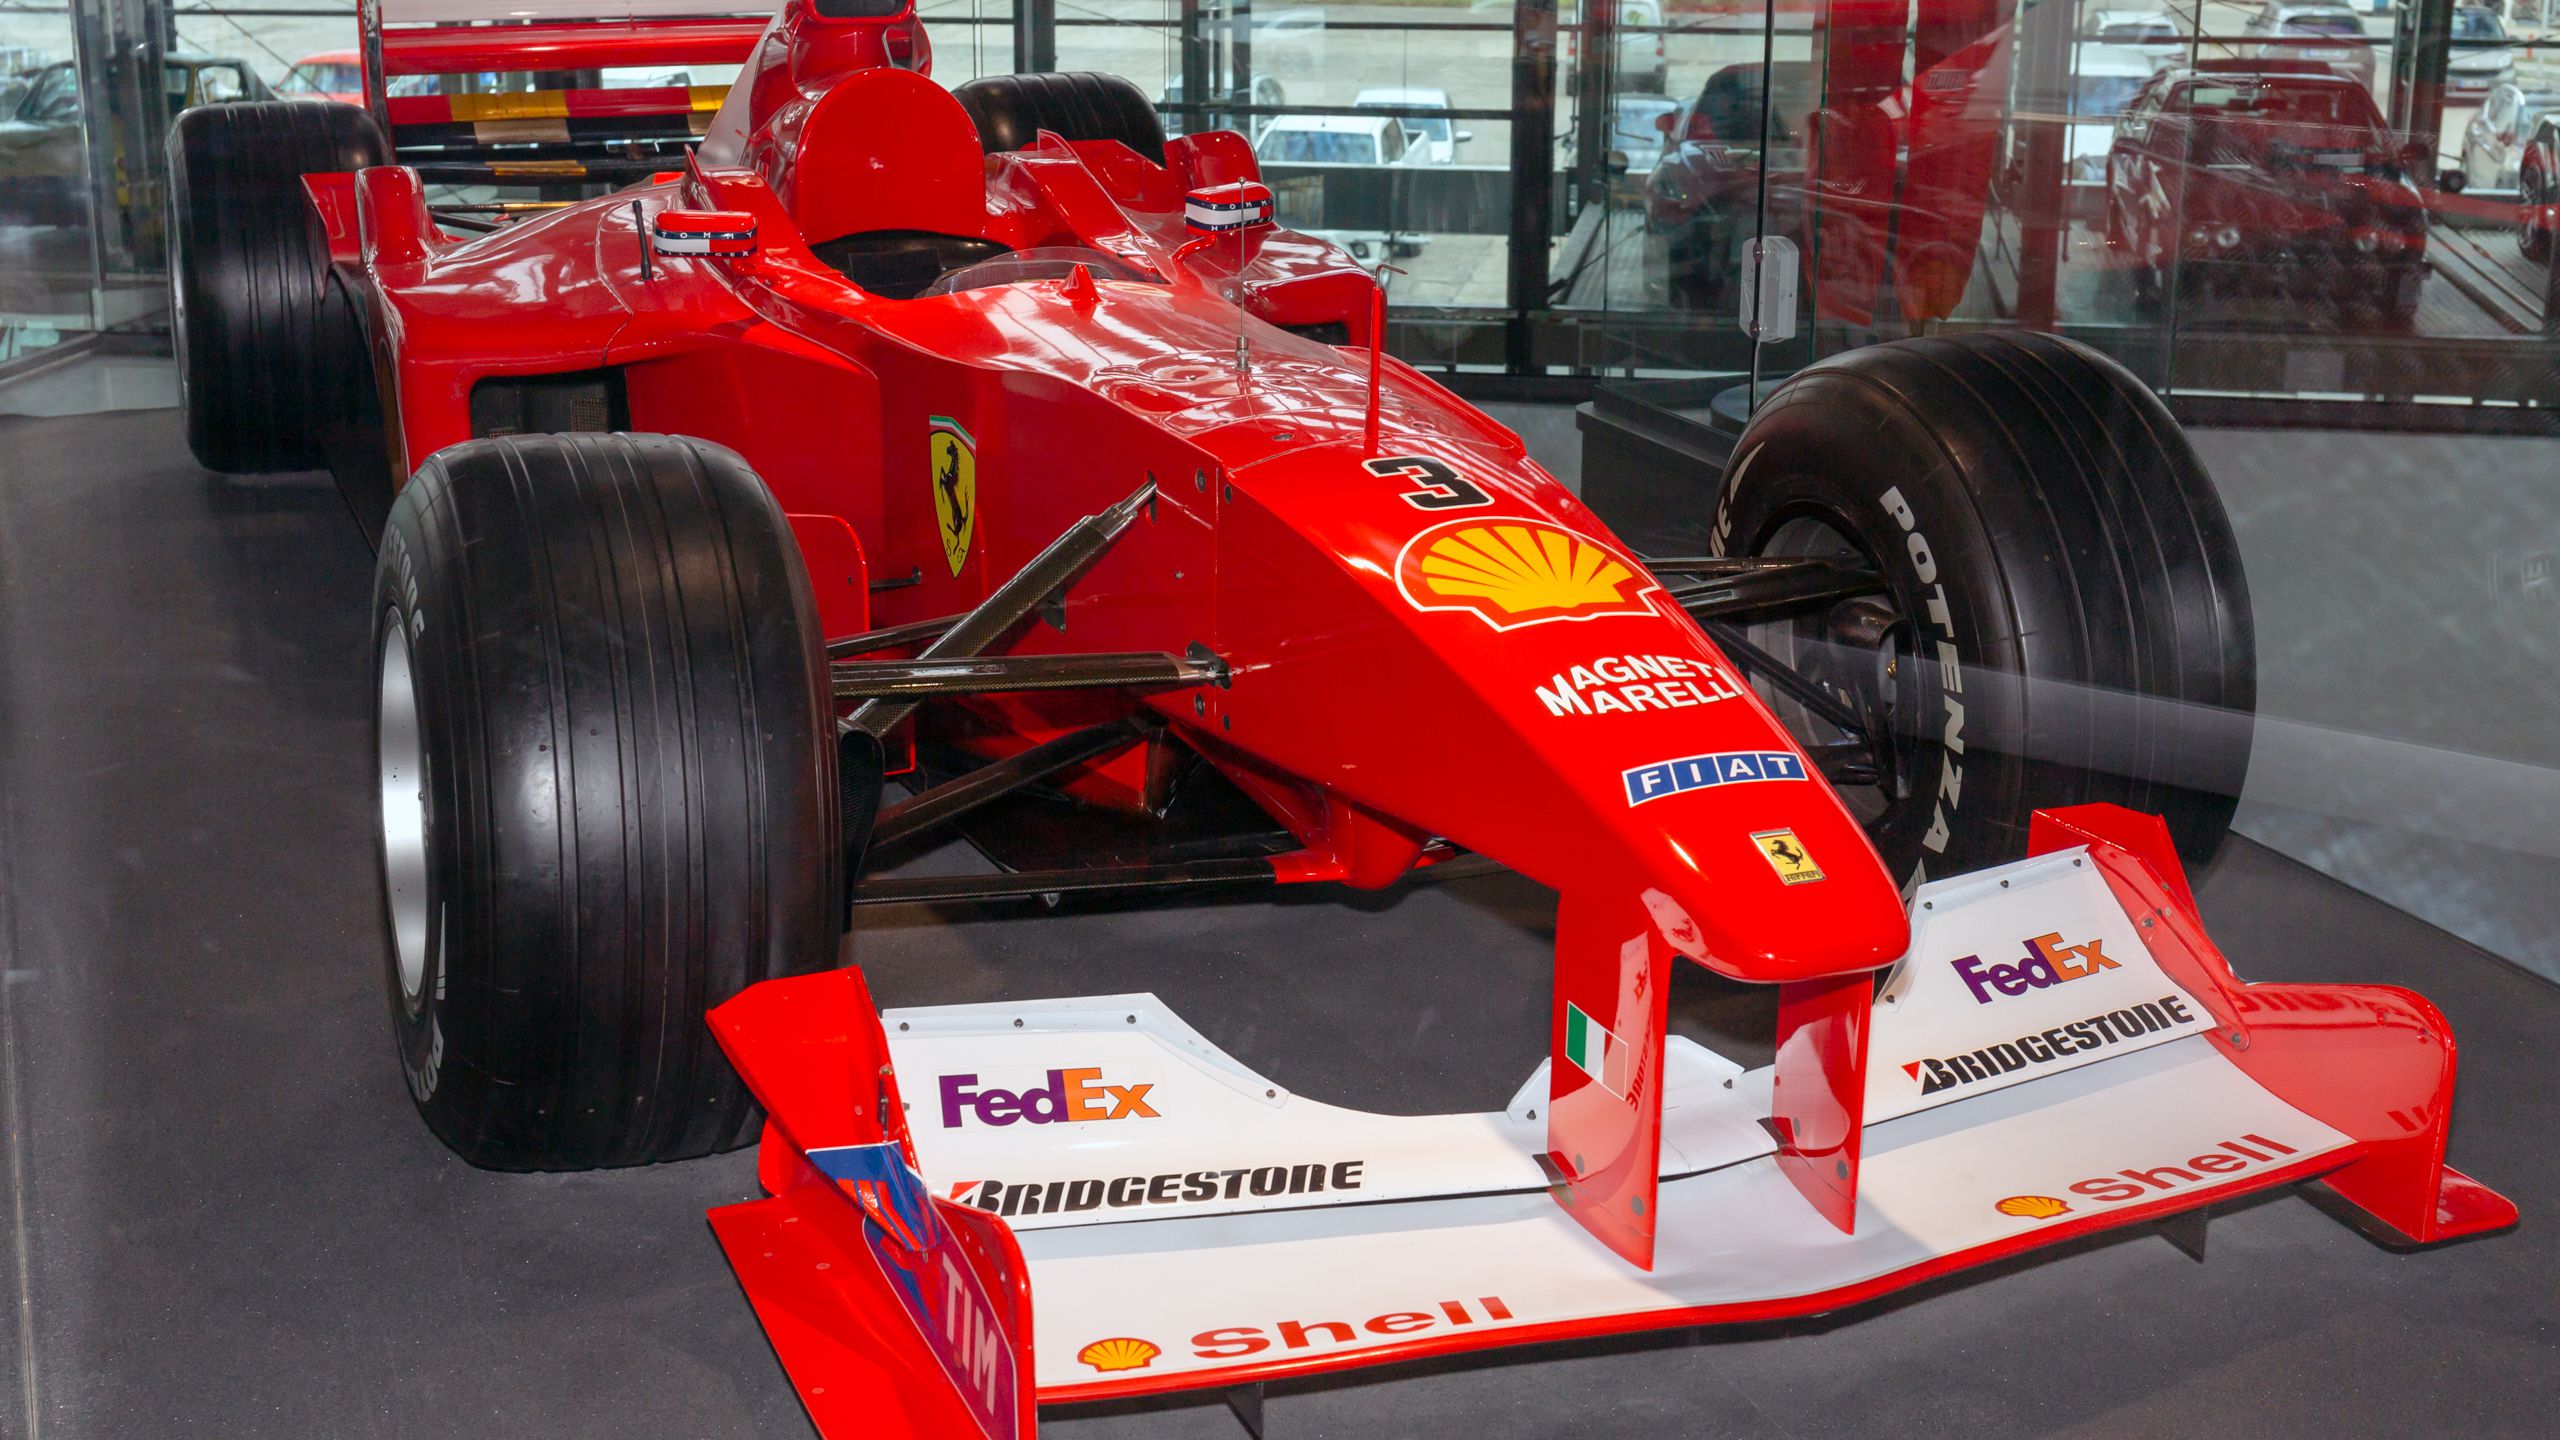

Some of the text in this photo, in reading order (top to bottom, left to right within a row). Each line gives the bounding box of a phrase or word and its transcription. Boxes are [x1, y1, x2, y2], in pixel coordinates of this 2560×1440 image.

[661, 230, 753, 240] TOMMY
[1362, 455, 1496, 511] 3
[1535, 668, 1744, 717] MARELLI
[1878, 486, 1965, 855] POTENZA
[1640, 757, 1790, 796] FIAT
[1951, 932, 2123, 1004] FedEx
[1902, 995, 2195, 1096] BRIDGESTONE
[938, 1067, 1162, 1128] FedEx
[950, 1160, 1364, 1217] BRIDGESTONE
[2068, 1133, 2300, 1202] Shell
[942, 1252, 998, 1417] TIM
[1191, 1296, 1514, 1360] Shell
